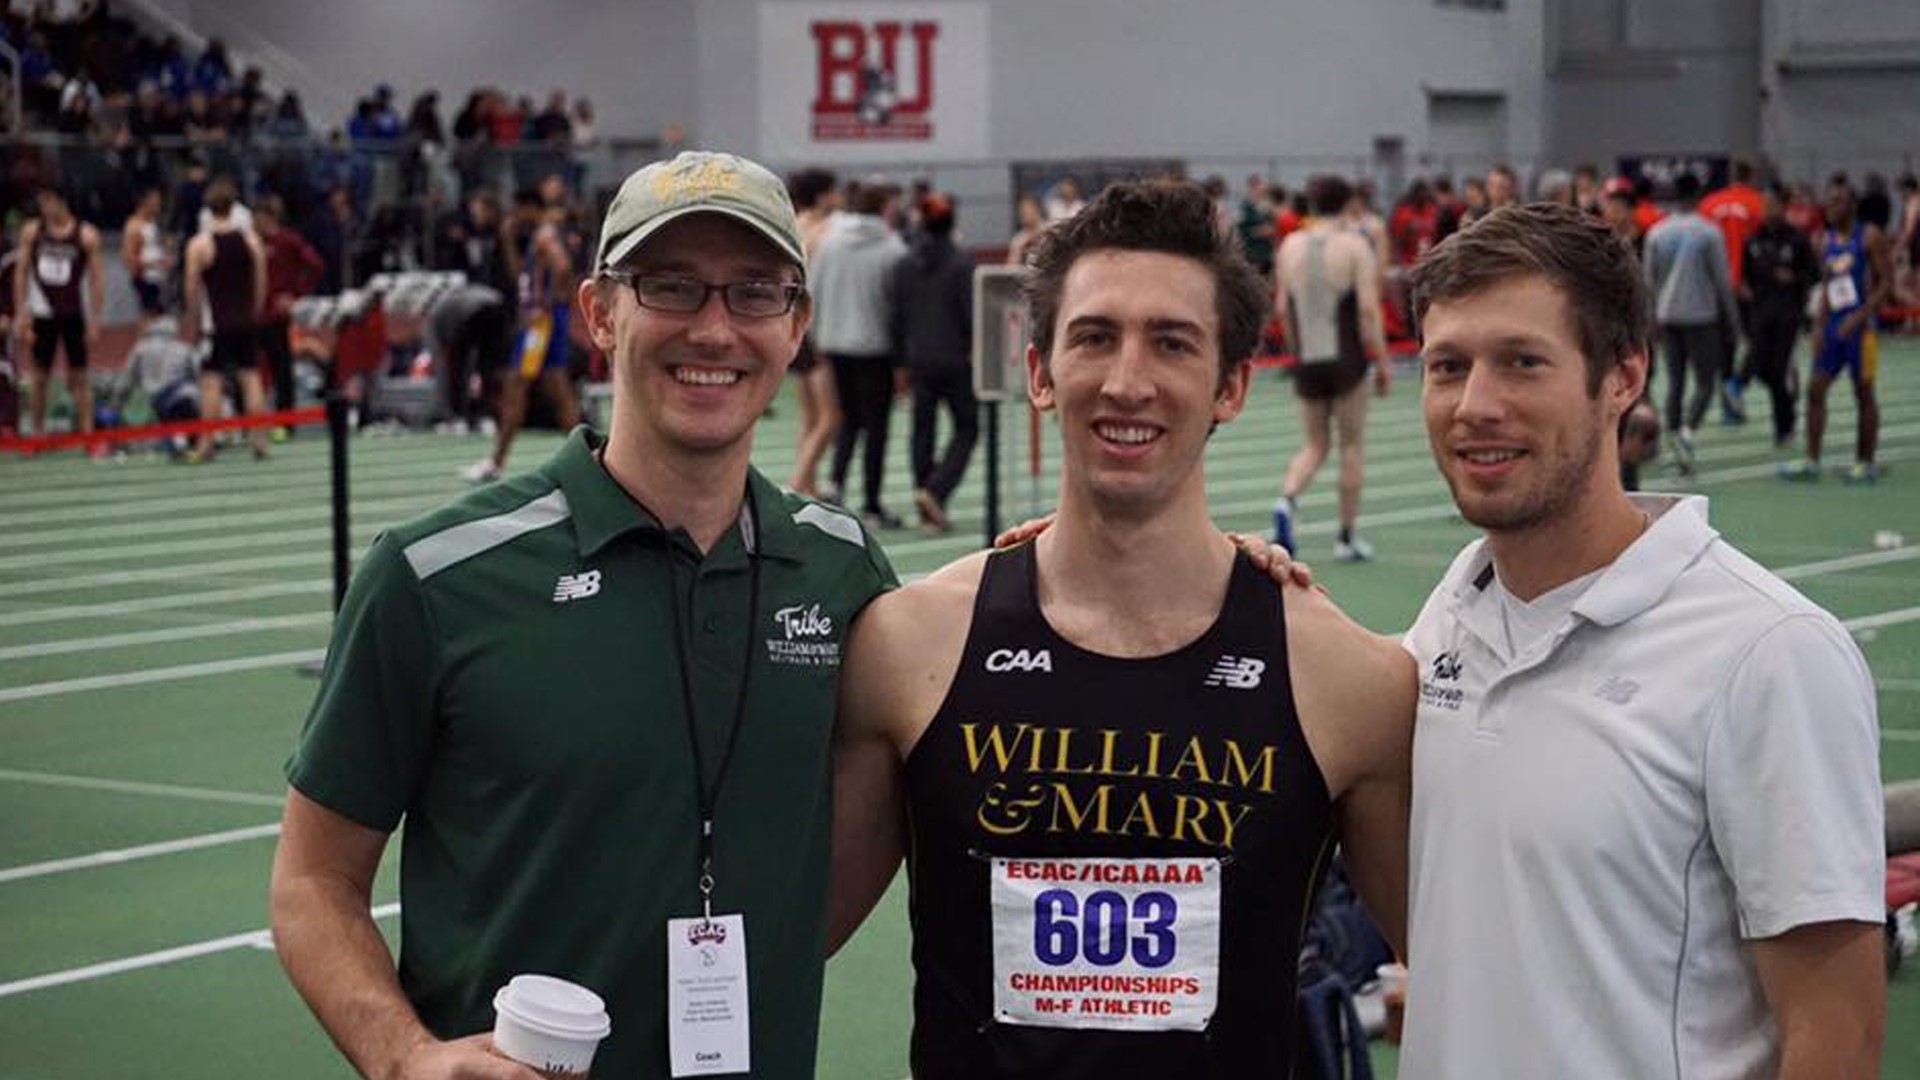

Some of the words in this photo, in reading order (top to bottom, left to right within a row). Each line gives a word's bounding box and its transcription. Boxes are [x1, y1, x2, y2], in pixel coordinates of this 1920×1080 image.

[811, 21, 938, 114] BU
[774, 603, 832, 640] Tribe
[985, 648, 1053, 673] CAA
[959, 722, 1279, 794] WILLIAM
[1006, 860, 1204, 884] ECAC/ICAAAA
[1033, 888, 1178, 969] 603
[1009, 972, 1200, 996] CHAMPIONSHIPS
[1035, 997, 1074, 1014] M-F
[1080, 998, 1172, 1016] ATHLETIC
